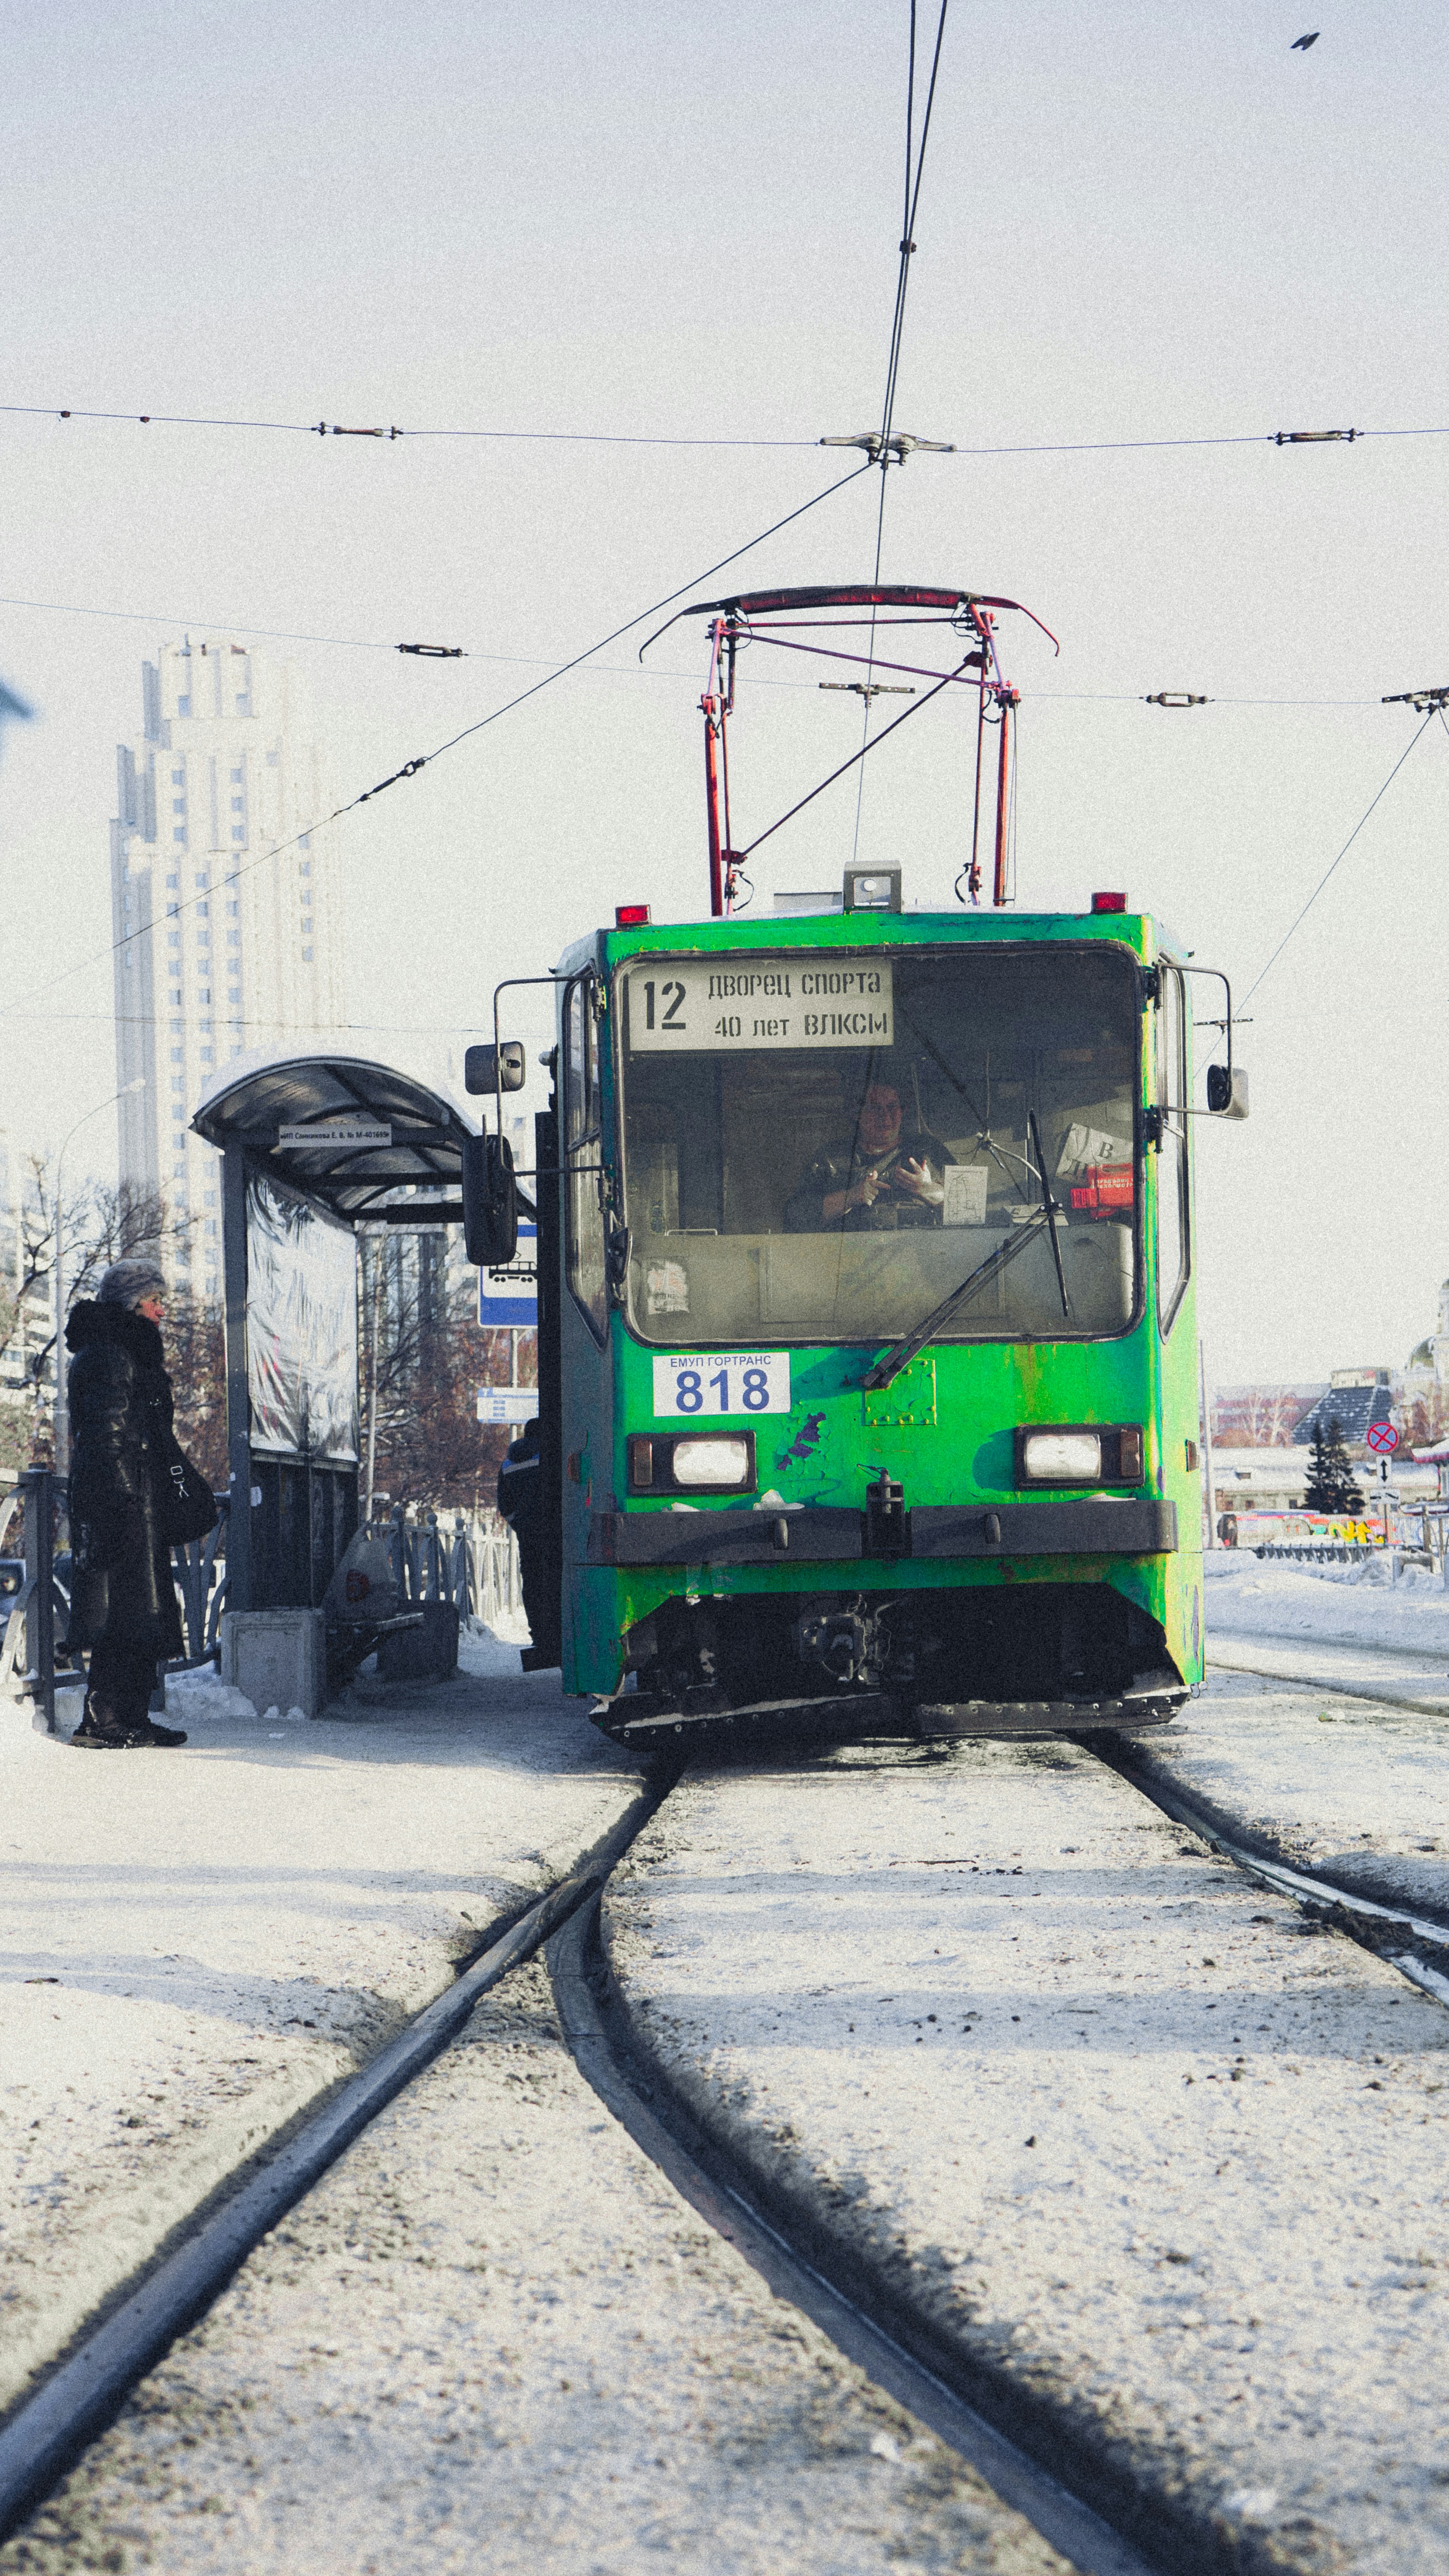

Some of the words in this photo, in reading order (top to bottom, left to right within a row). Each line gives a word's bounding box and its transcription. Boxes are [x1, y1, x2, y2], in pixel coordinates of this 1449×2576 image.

[644, 981, 686, 1030] 12
[715, 1016, 741, 1037] 40
[804, 1012, 888, 1036] ВЛКСМ
[670, 1358, 703, 1367] ЕМУП
[708, 1355, 771, 1366] ГОРТРАНС
[676, 1369, 769, 1413] 818
